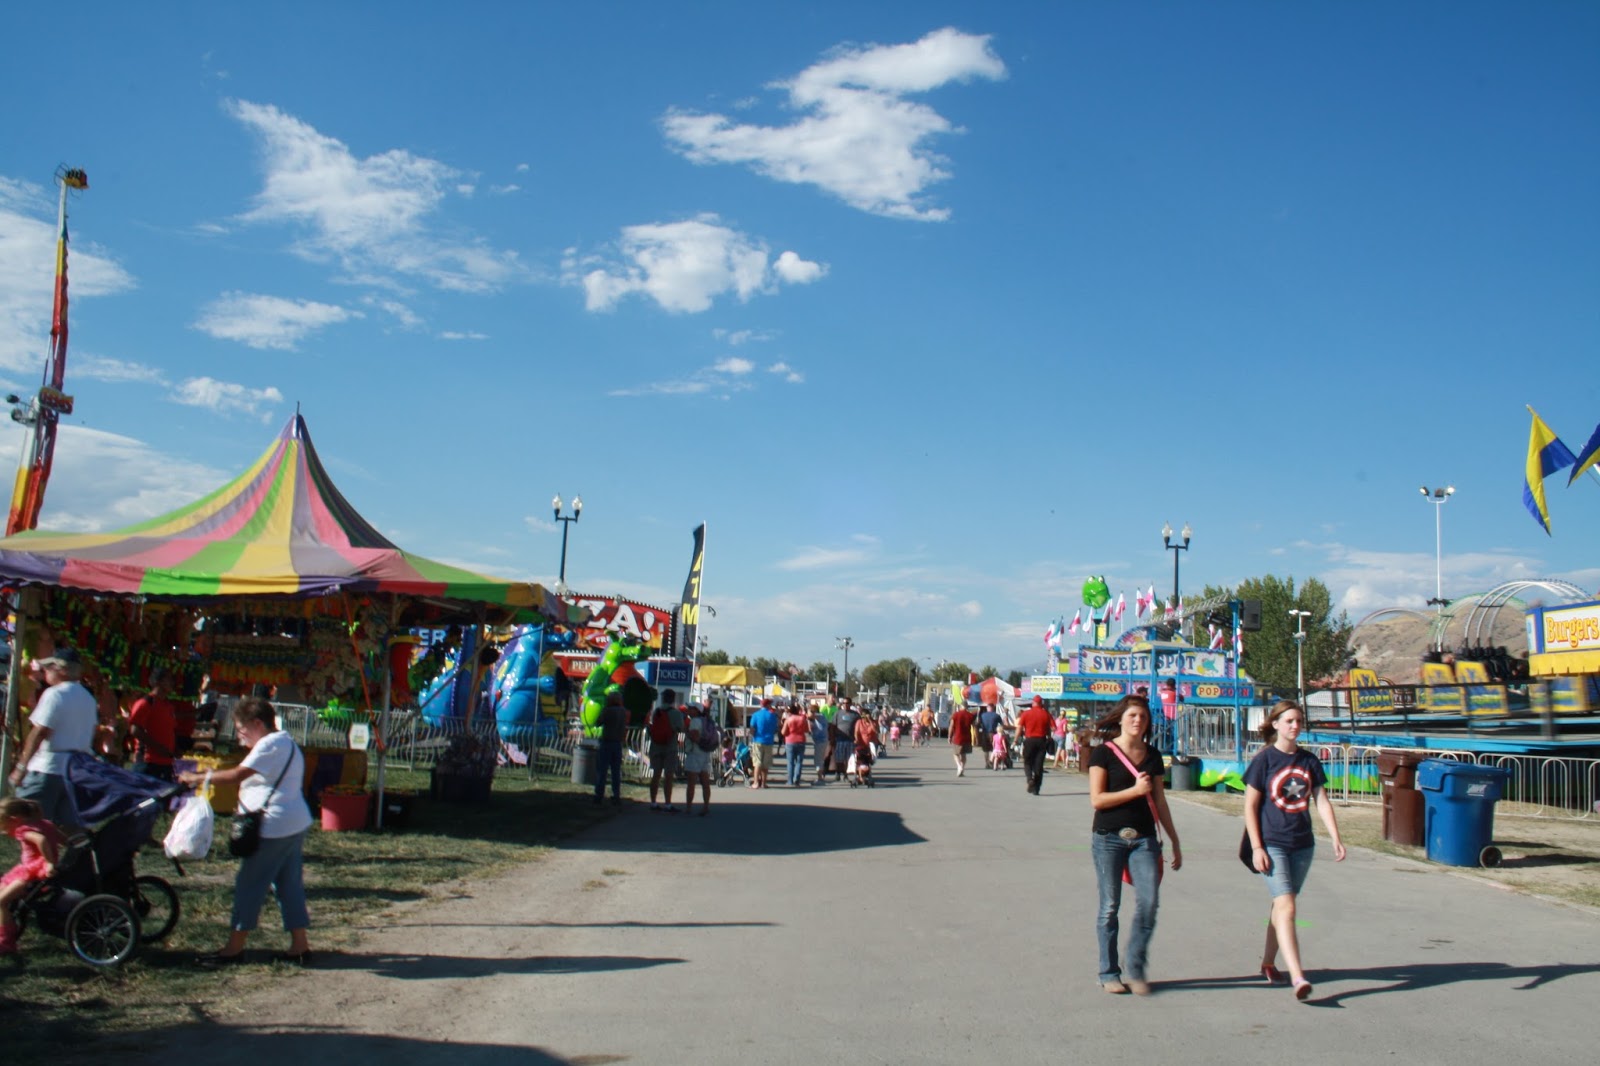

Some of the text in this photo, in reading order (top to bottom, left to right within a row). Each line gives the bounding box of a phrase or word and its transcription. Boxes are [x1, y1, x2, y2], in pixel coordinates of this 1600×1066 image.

[681, 551, 703, 625] ATM
[562, 598, 655, 641] ZA!
[409, 628, 447, 646] ER
[1546, 616, 1599, 648] Burgers
[1093, 654, 1196, 671] SWEET SPOT
[1090, 683, 1123, 693] APPLES
[1198, 687, 1250, 696] POPCON
